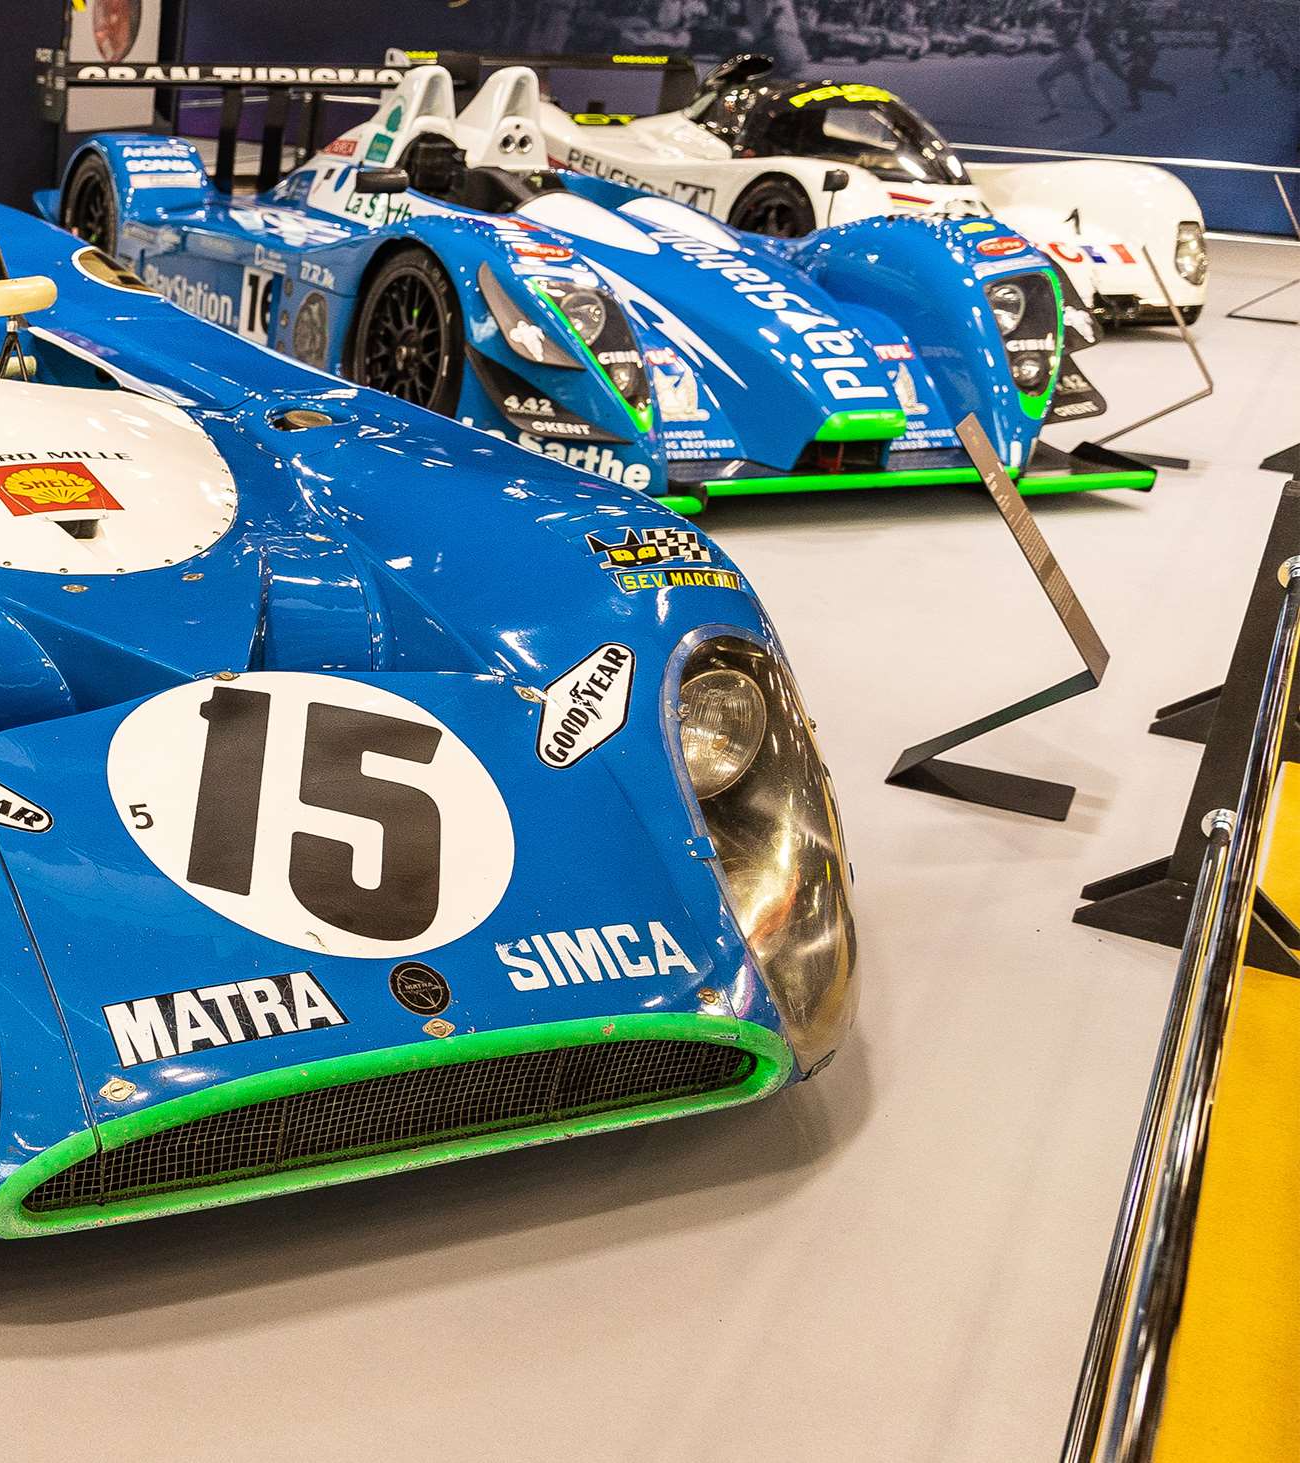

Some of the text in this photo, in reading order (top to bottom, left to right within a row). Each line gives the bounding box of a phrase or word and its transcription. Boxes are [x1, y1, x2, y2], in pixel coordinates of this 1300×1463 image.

[47, 451, 134, 462] MILLE
[18, 478, 84, 490] SHELL
[669, 572, 738, 590] MARCHAL
[129, 803, 154, 829] 5
[187, 687, 443, 942] 15
[496, 920, 699, 992] SIMCA
[103, 971, 344, 1067] MATRA
